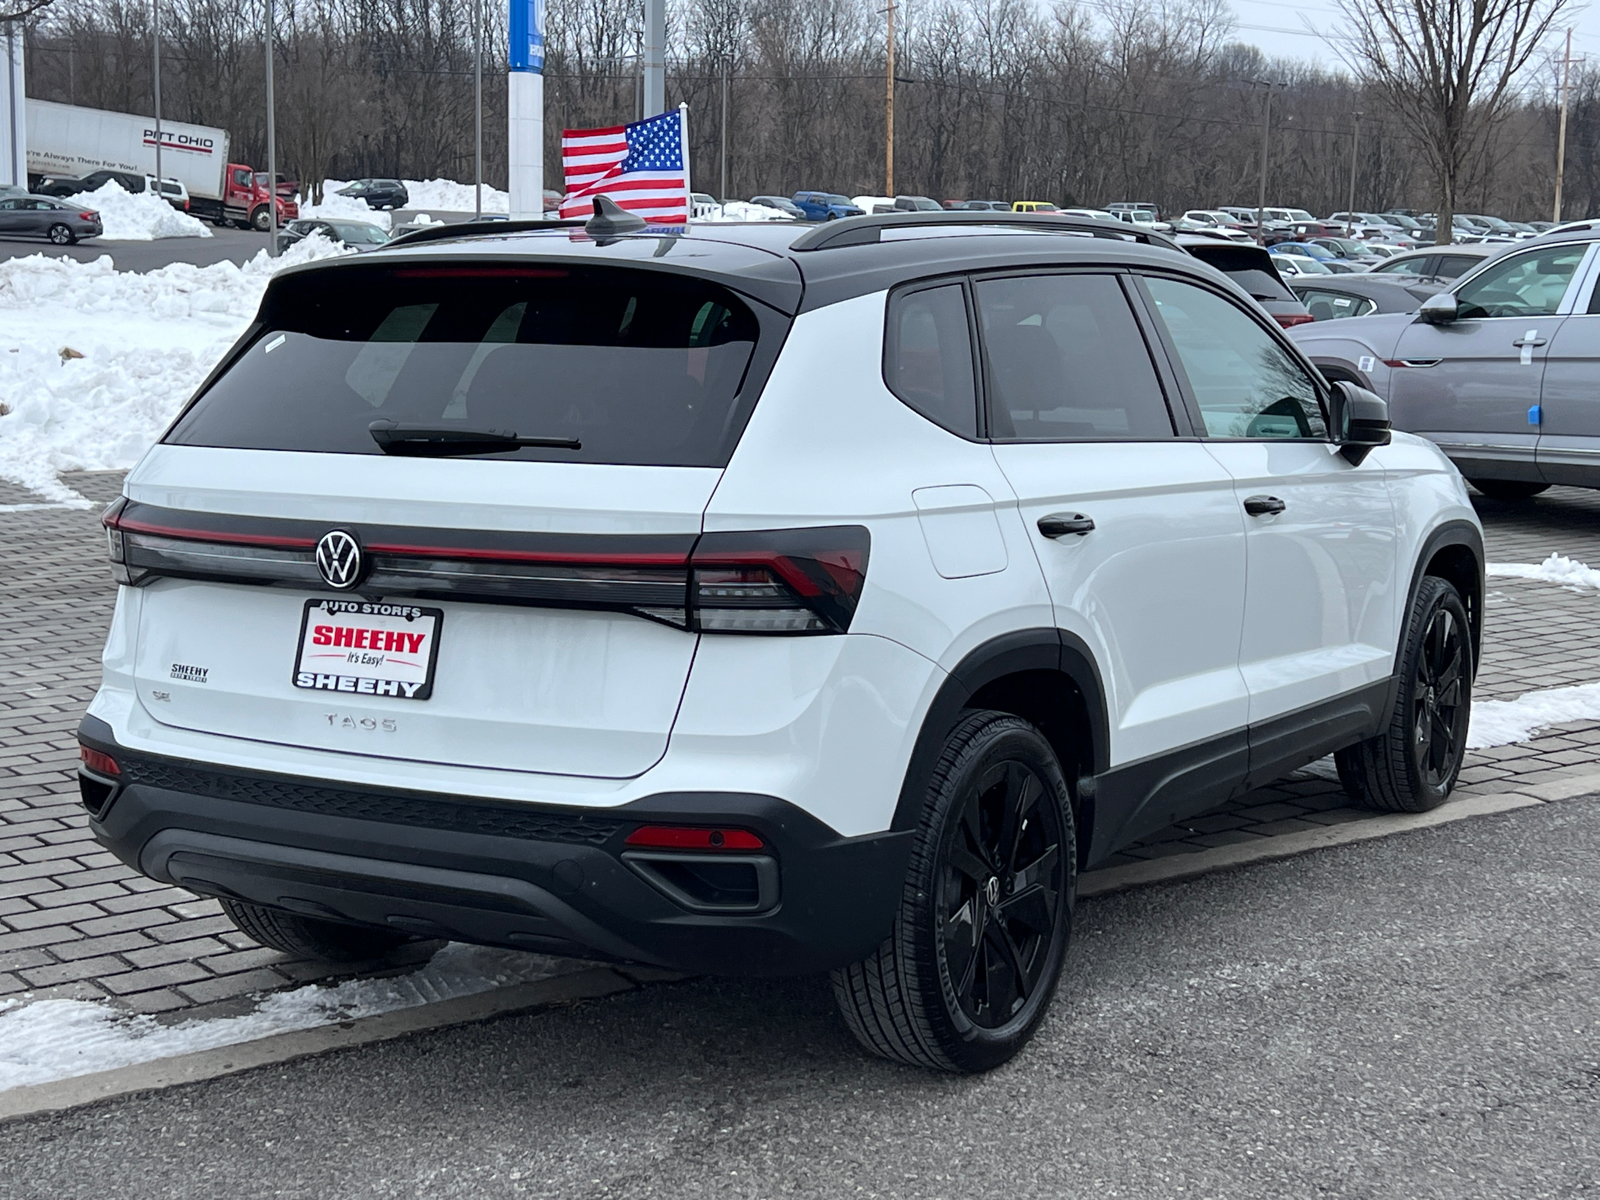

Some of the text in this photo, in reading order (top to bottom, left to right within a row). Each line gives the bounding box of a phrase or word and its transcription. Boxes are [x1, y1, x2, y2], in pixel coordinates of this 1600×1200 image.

[143, 129, 214, 148] PITT OHIO
[26, 150, 138, 172] e're Always There For You!
[319, 600, 422, 618] AUTO STORES
[312, 624, 426, 654] SHEEHY
[347, 651, 385, 668] It's Easy!
[171, 663, 209, 677] SHEEHY
[297, 672, 423, 698] SHEEHY
[324, 712, 397, 732] TAOS
